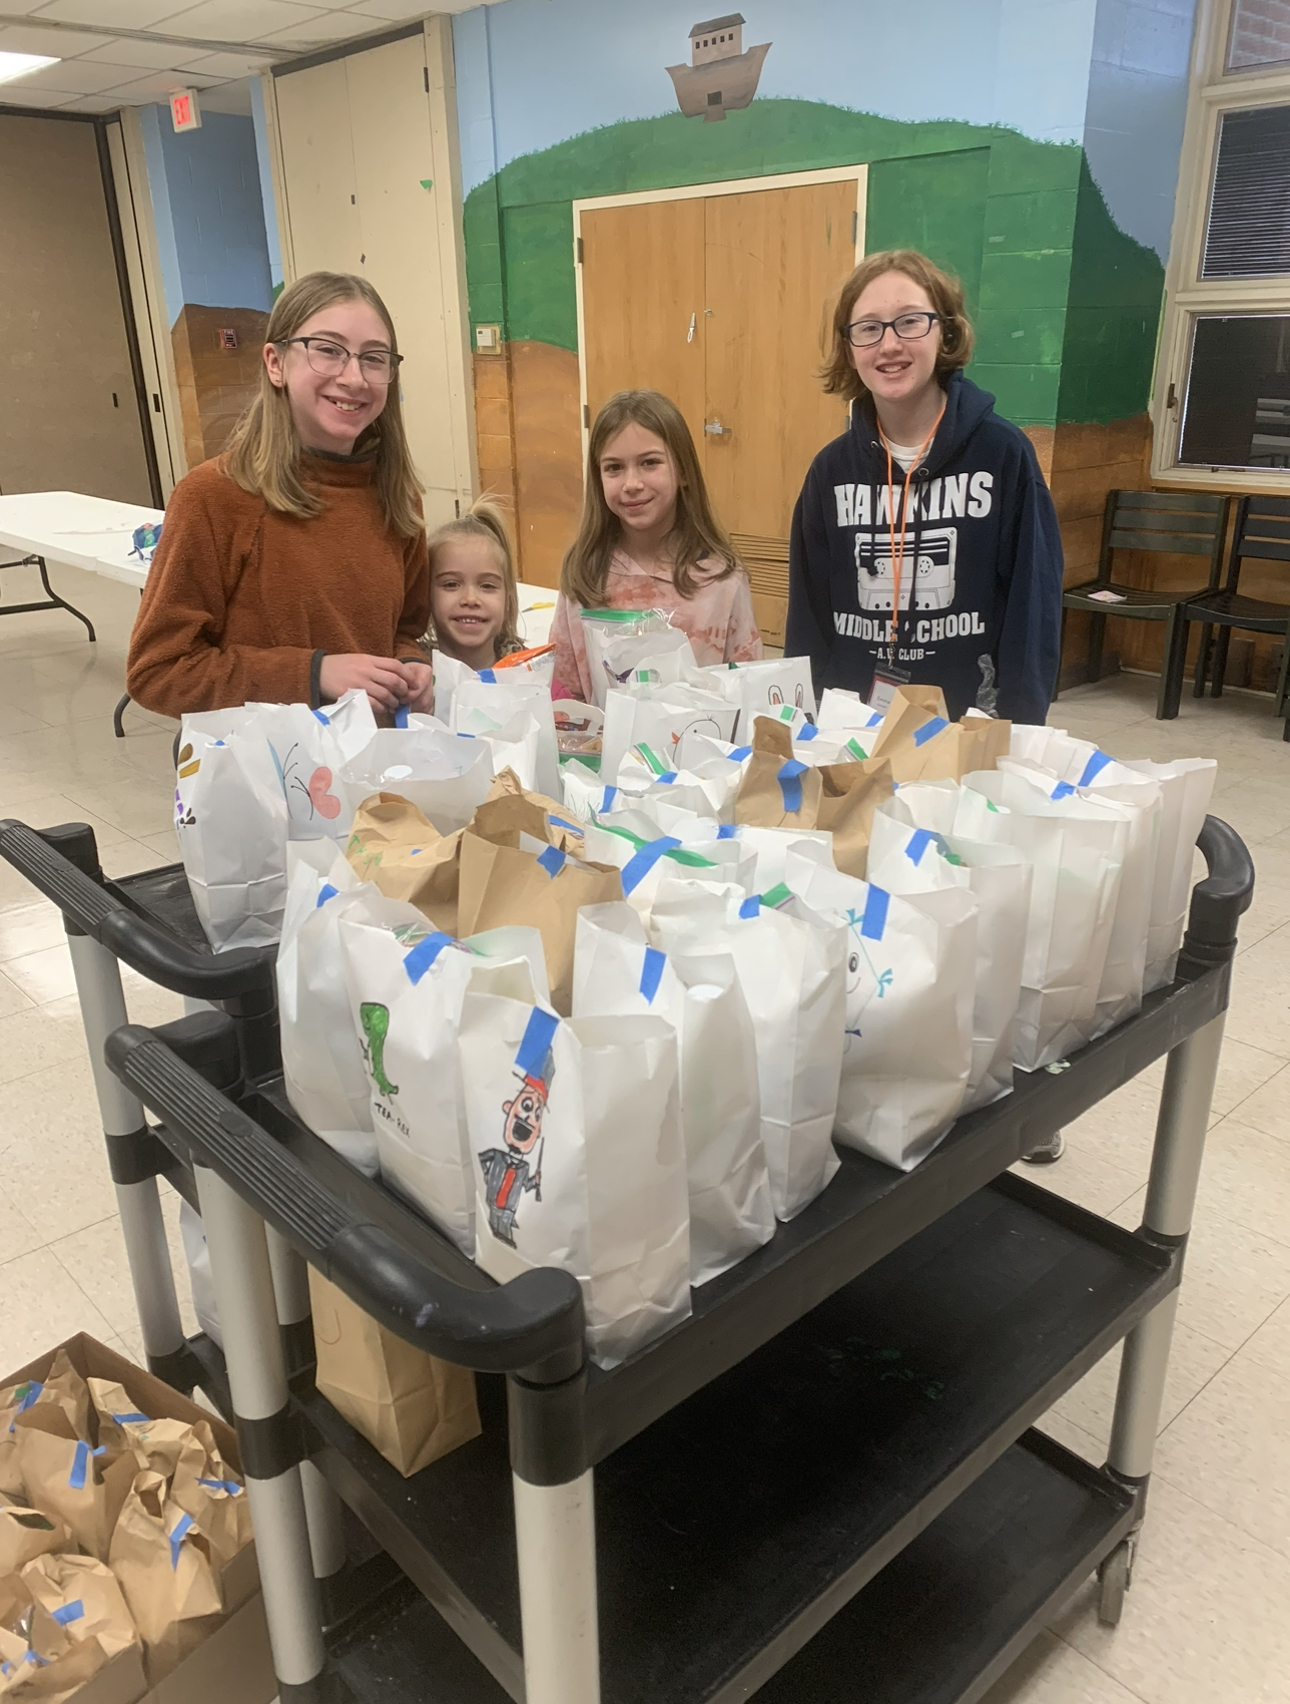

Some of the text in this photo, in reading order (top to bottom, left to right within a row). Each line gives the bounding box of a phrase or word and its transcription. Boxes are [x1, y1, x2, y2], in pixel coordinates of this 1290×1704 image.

[834, 471, 994, 527] HAWKINS
[834, 611, 898, 642] MIDDLE
[898, 648, 925, 660] CLUB
